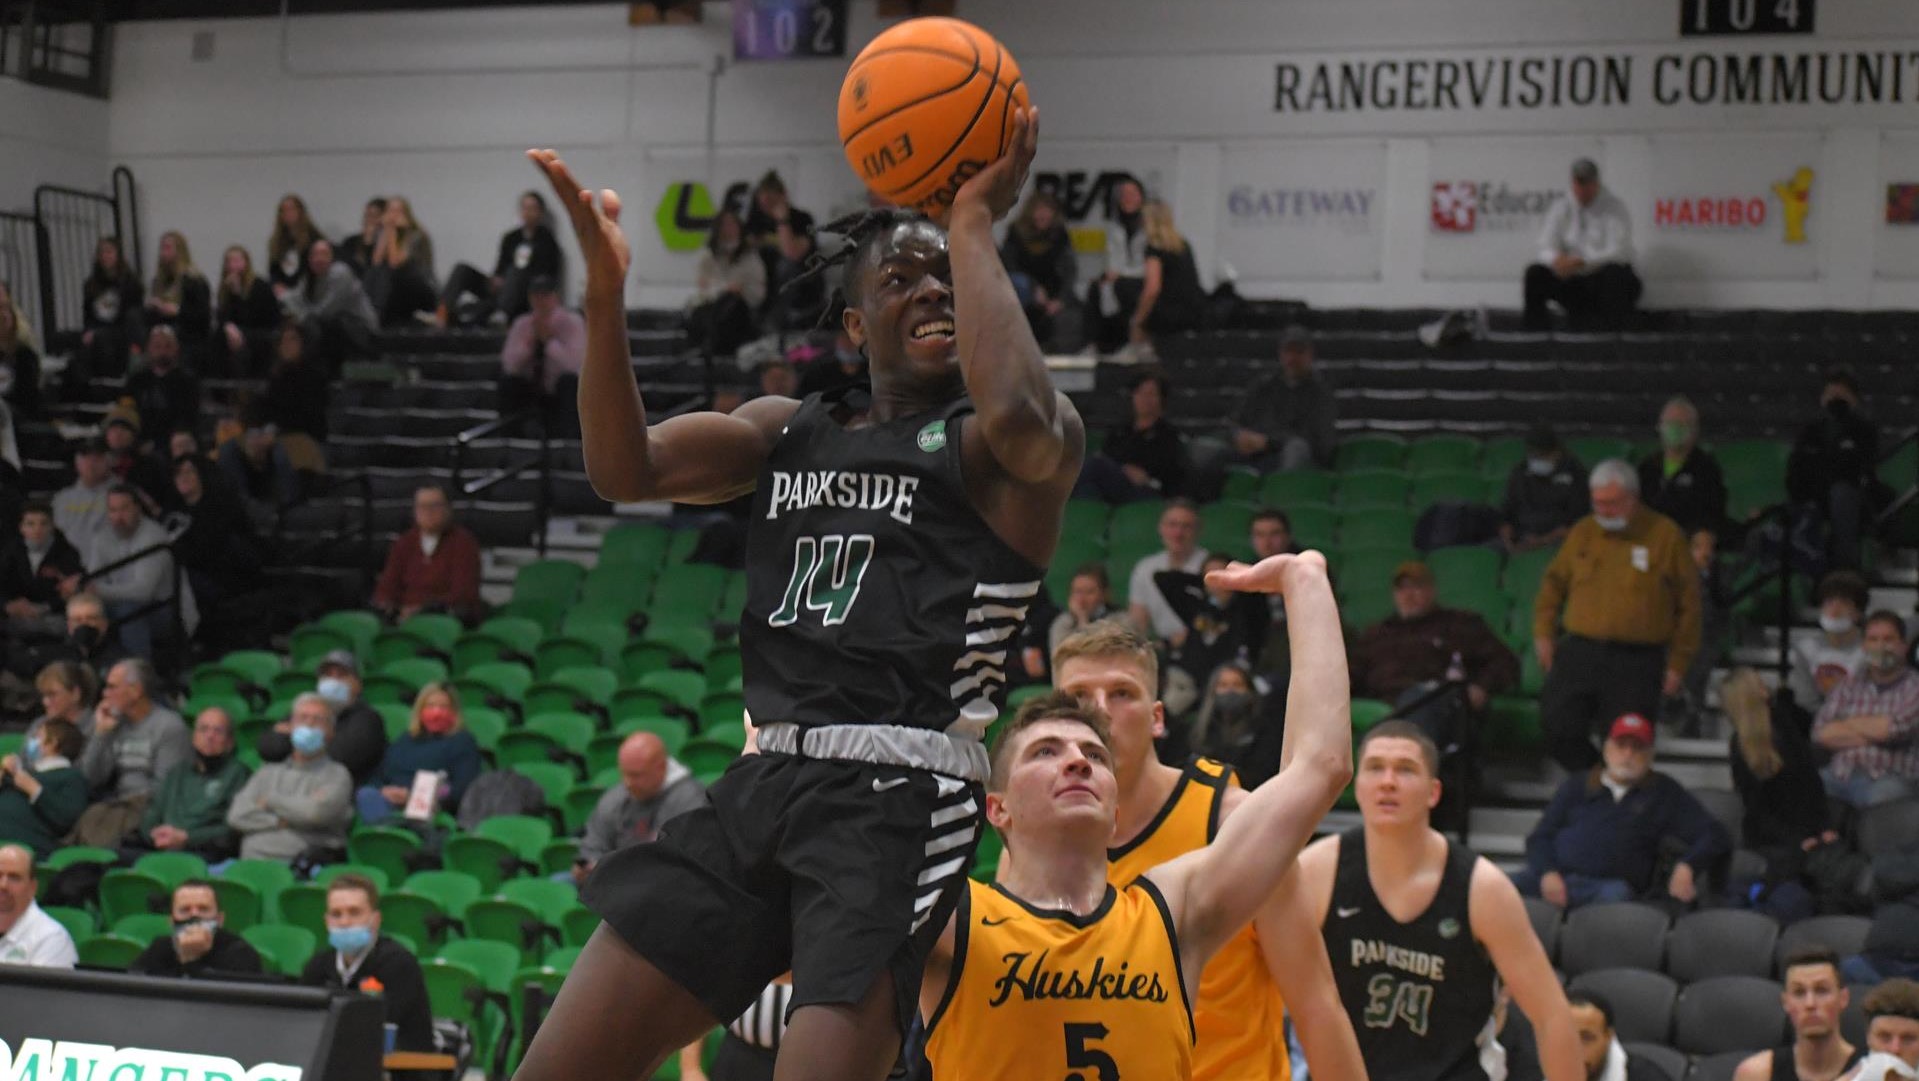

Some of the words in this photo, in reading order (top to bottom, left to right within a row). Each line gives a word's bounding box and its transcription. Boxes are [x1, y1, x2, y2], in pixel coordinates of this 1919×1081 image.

[1273, 55, 1634, 113] RANGERVISION
[1228, 184, 1377, 218] GATEWAY
[1654, 198, 1767, 227] HARIBO
[766, 471, 919, 525] PARKSIDE
[768, 534, 875, 627] 14
[989, 948, 1168, 1008] Huskies
[1363, 973, 1434, 1037] 34
[1063, 1022, 1120, 1081] 5
